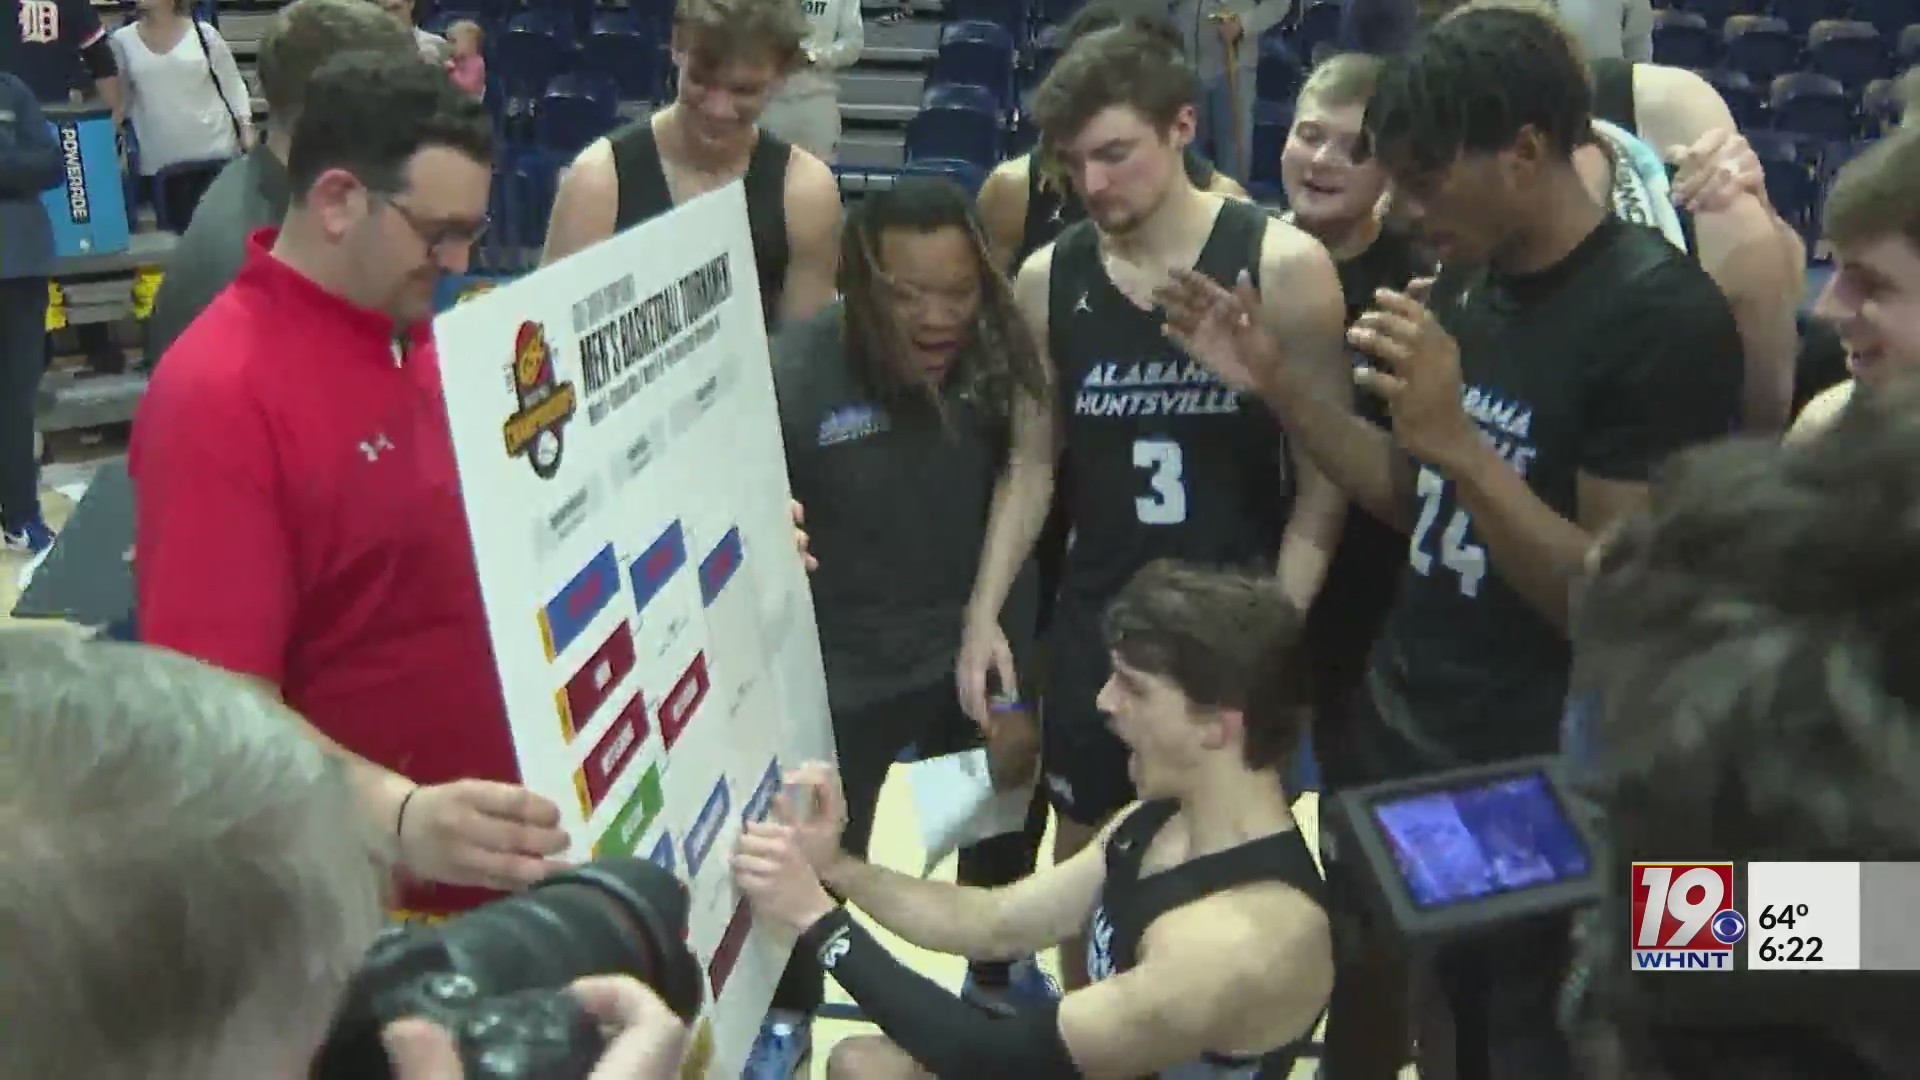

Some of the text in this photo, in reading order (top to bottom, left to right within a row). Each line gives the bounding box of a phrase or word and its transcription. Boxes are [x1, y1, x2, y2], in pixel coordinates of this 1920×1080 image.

[62, 128, 87, 219] POWERADE
[1073, 388, 1241, 417] HUNTSVILLE
[1132, 439, 1187, 525] 3
